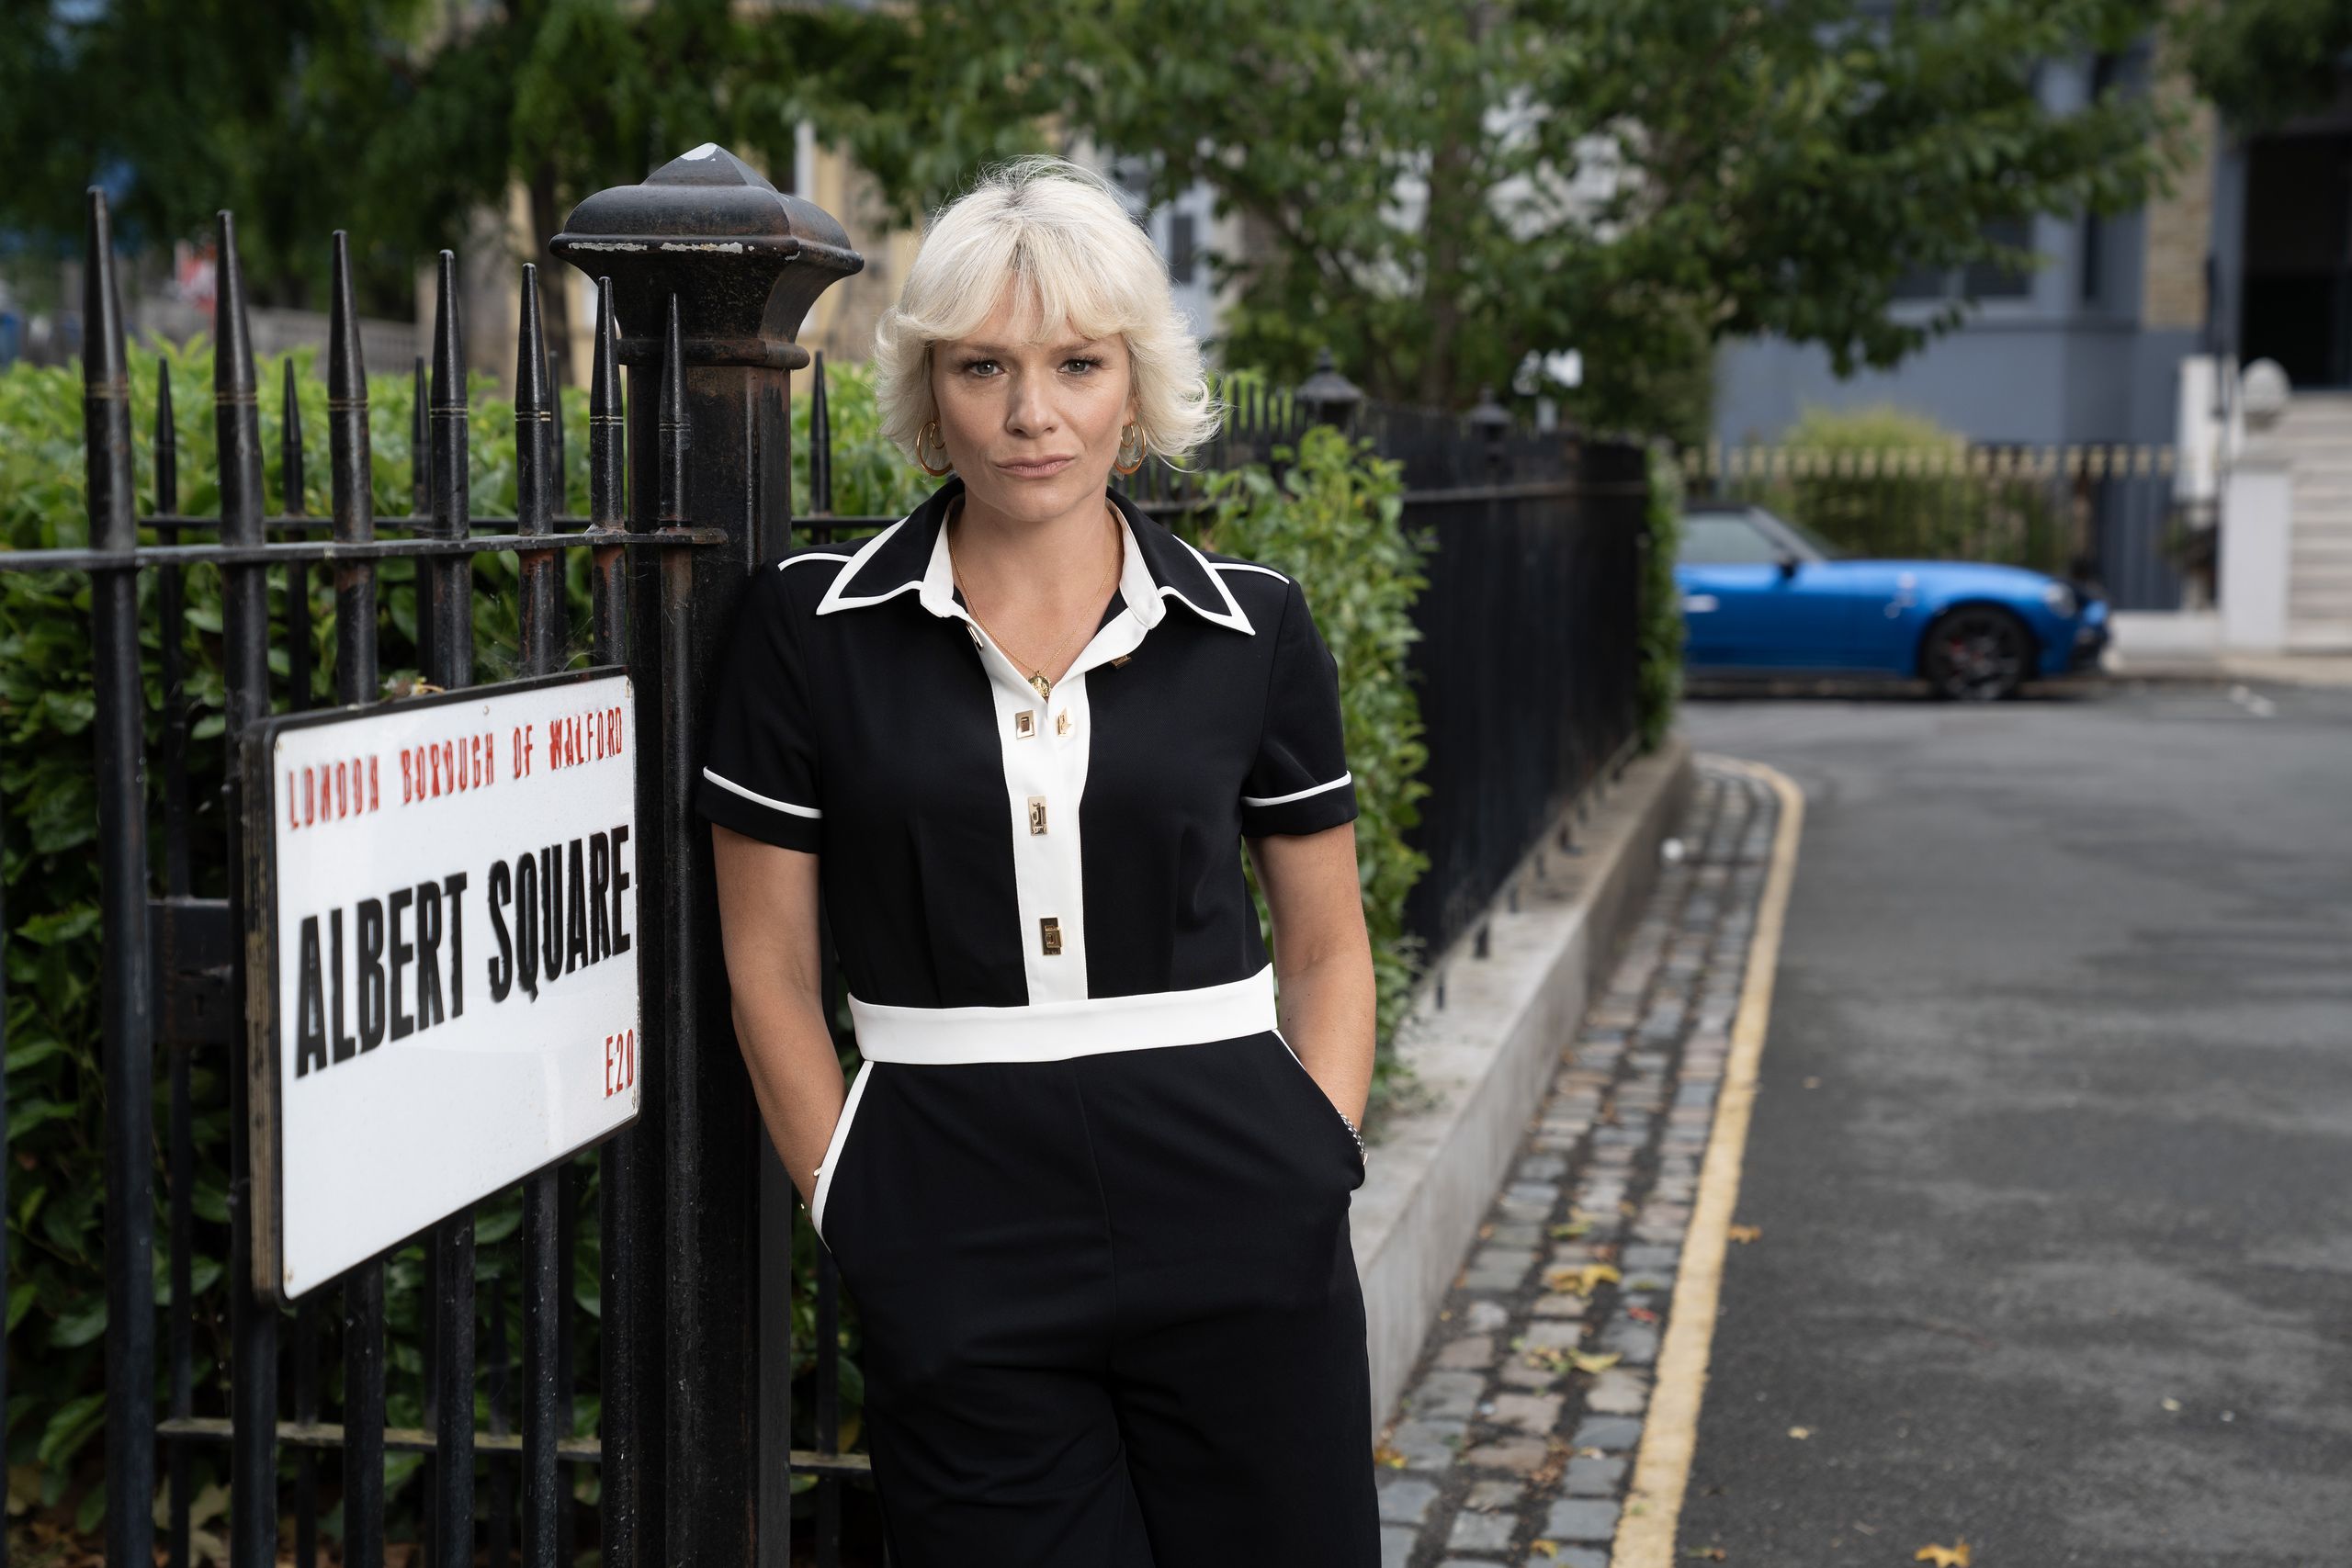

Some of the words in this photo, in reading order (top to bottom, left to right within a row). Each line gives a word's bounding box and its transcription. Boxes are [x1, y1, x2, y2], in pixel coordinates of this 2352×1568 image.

[288, 756, 379, 829] LONDON
[400, 733, 494, 805] BOROUGH
[513, 724, 533, 780] OF
[548, 705, 623, 770] WALFORD
[296, 872, 468, 1078] ALBERT
[487, 824, 631, 1003] SQUARE
[605, 1028, 634, 1099] E20
